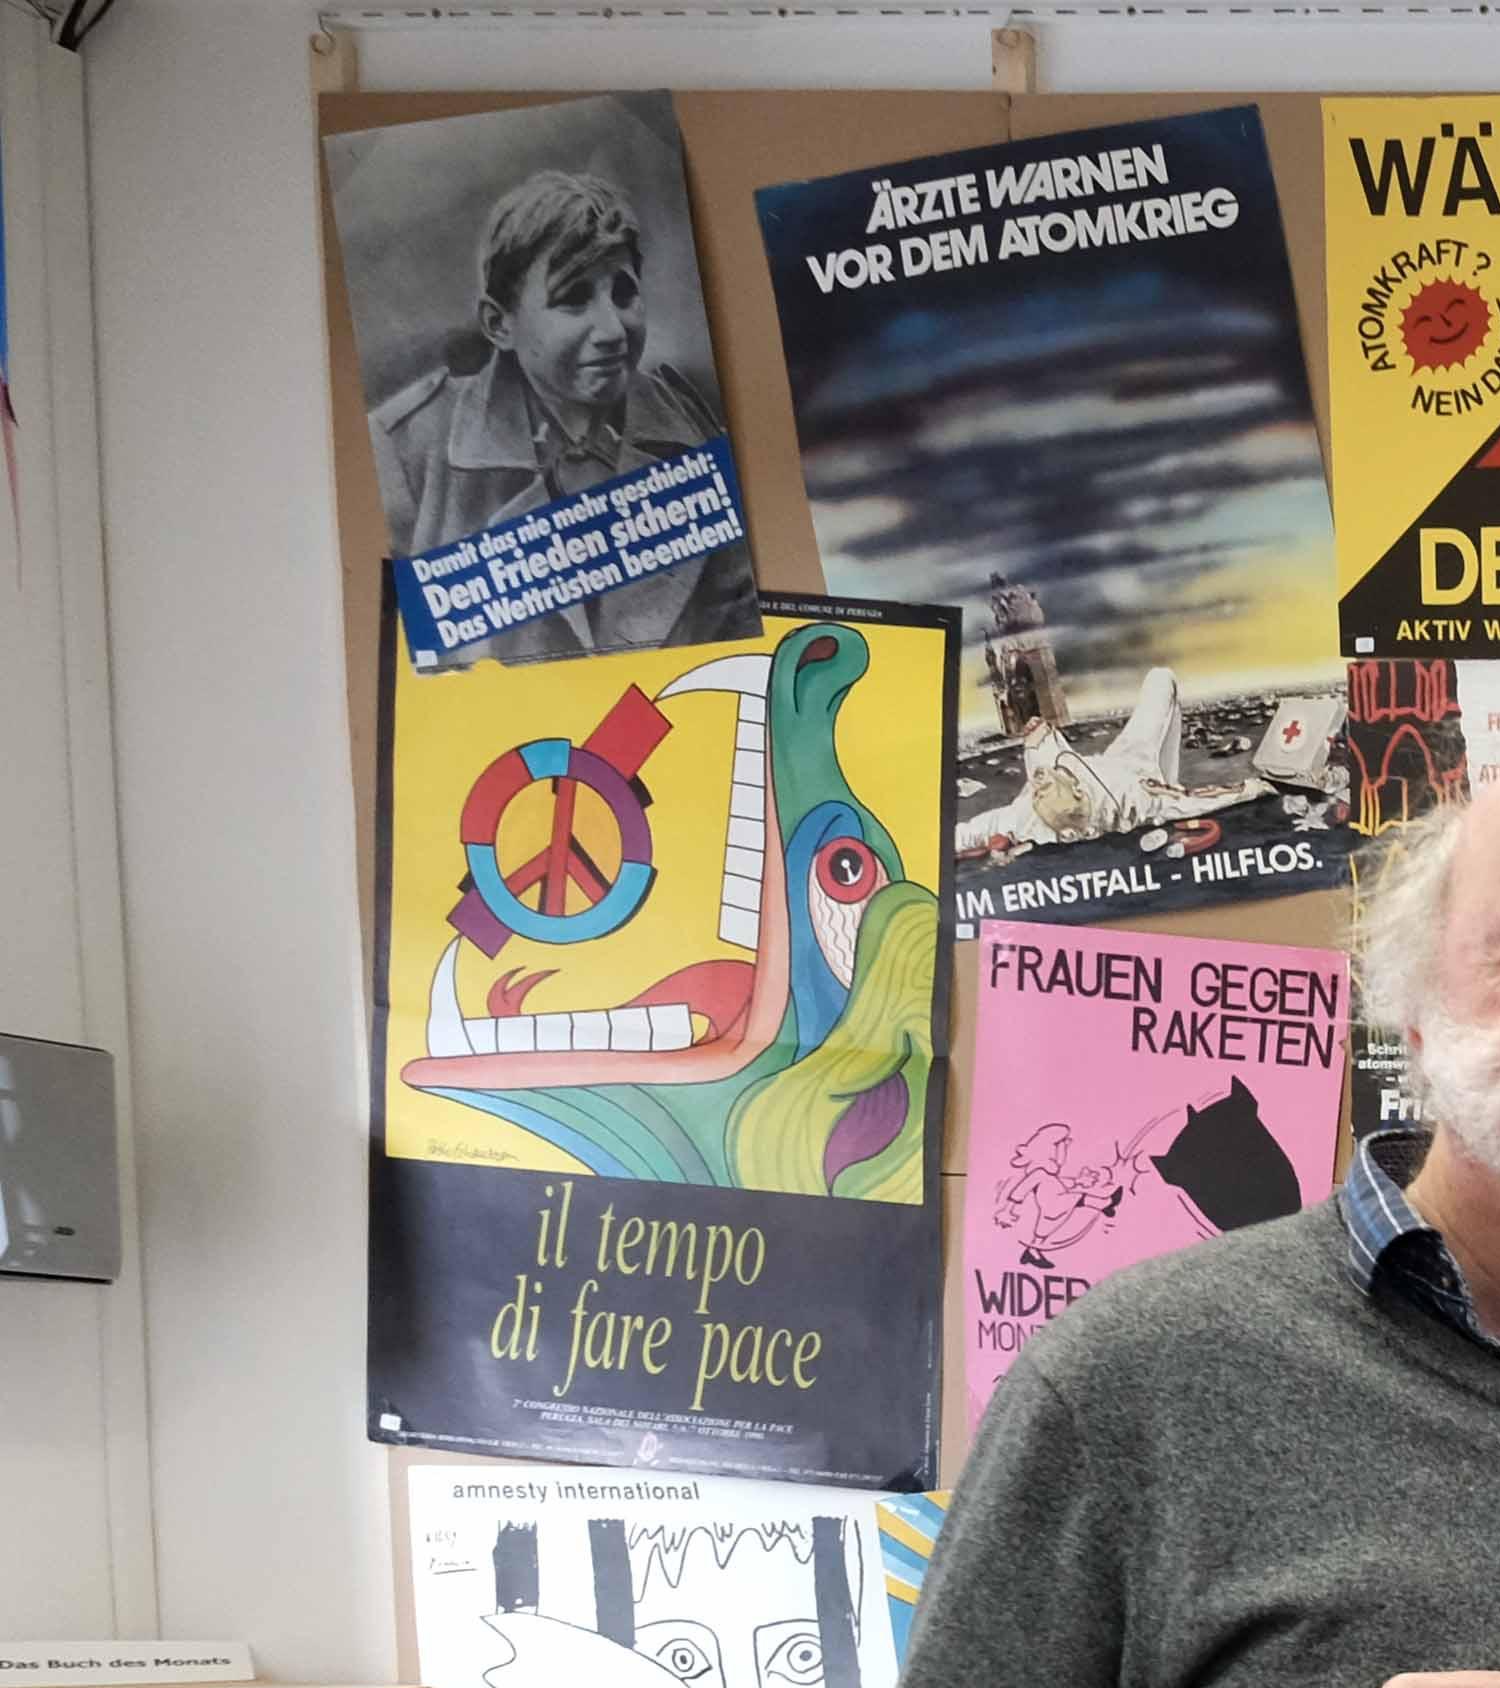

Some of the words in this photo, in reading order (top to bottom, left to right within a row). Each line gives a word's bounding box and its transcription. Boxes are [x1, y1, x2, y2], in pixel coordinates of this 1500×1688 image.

[863, 163, 980, 236] ÄRZTE
[984, 144, 1169, 211] WARNEN
[805, 242, 896, 294] VOR
[899, 222, 987, 279] DEM
[996, 188, 1240, 262] ATOMKRIEG
[422, 572, 491, 619] Den
[488, 527, 609, 594] Frieden
[610, 471, 733, 548] sichern!
[1396, 619, 1471, 641] AKTIV
[989, 943, 1163, 1003] FRAUEN
[1189, 961, 1340, 1022] GEGEN
[1129, 1005, 1335, 1070] RAKETEN
[534, 1181, 574, 1270] il
[595, 1201, 766, 1314] tempo
[489, 1274, 544, 1362] di
[553, 1278, 673, 1397] fare
[690, 1309, 822, 1411] pace
[452, 1480, 550, 1506] amnesty
[556, 1480, 700, 1503] international
[0, 1660, 39, 1670] Das
[48, 1659, 102, 1669] Buch
[109, 1659, 147, 1668] des
[154, 1657, 232, 1667] Monats
